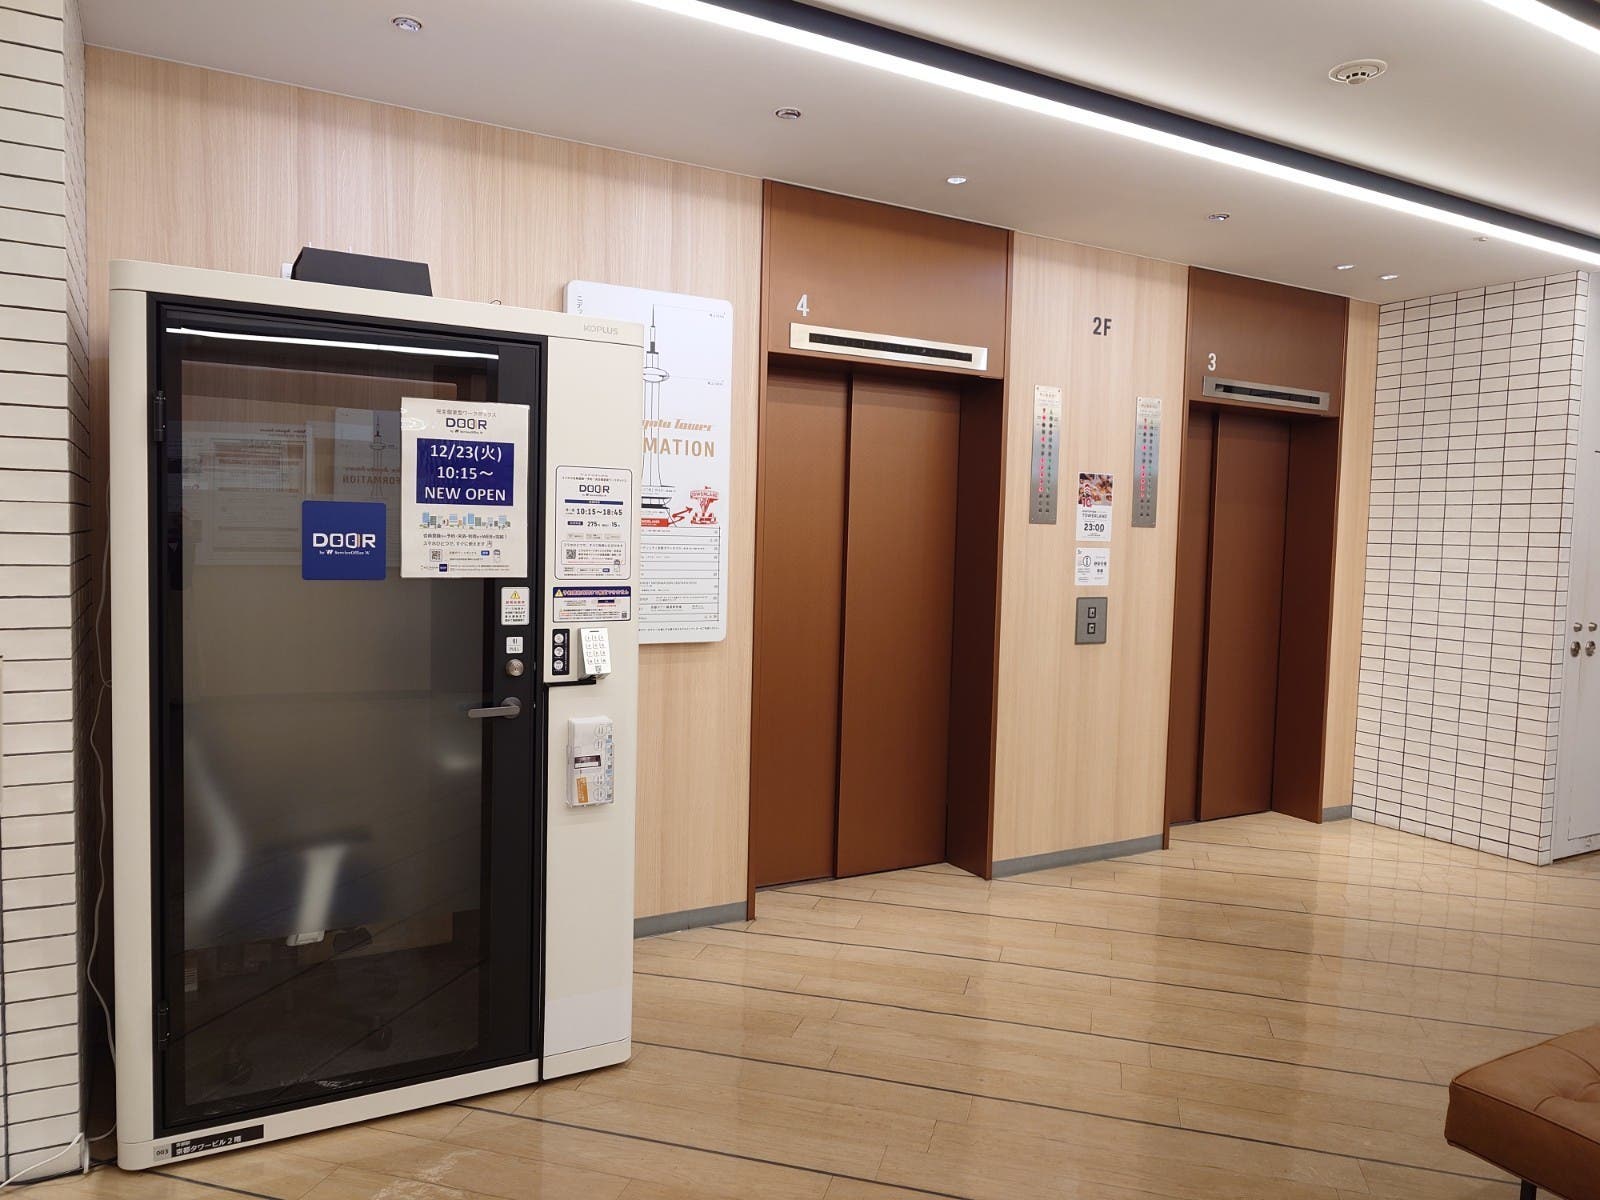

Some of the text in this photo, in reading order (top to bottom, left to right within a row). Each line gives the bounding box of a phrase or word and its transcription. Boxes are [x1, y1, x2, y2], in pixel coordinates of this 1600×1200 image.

[796, 294, 810, 317] 4
[583, 324, 619, 336] KOPLUS
[1092, 316, 1112, 336] 2F
[1207, 352, 1217, 372] 3
[430, 443, 502, 463] 12/23(火)
[424, 486, 506, 501] NEW OPEN
[1083, 523, 1105, 533] 23:00
[312, 532, 376, 549] DOOR
